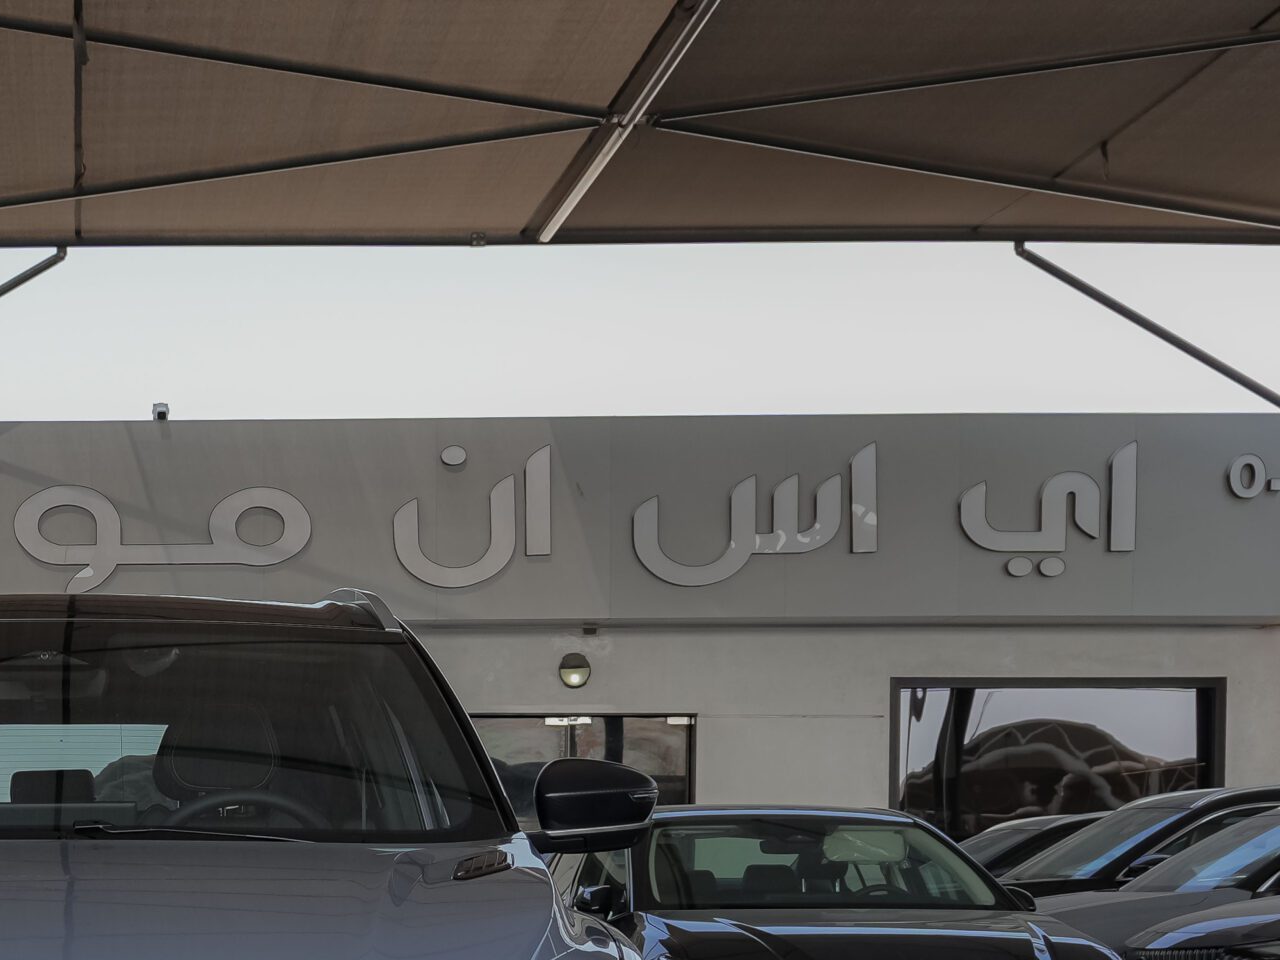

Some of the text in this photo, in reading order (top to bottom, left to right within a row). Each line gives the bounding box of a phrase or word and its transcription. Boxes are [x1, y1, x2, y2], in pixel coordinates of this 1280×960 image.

[392, 444, 552, 589] ان
[632, 441, 878, 588] اس
[959, 440, 1138, 577] اي
